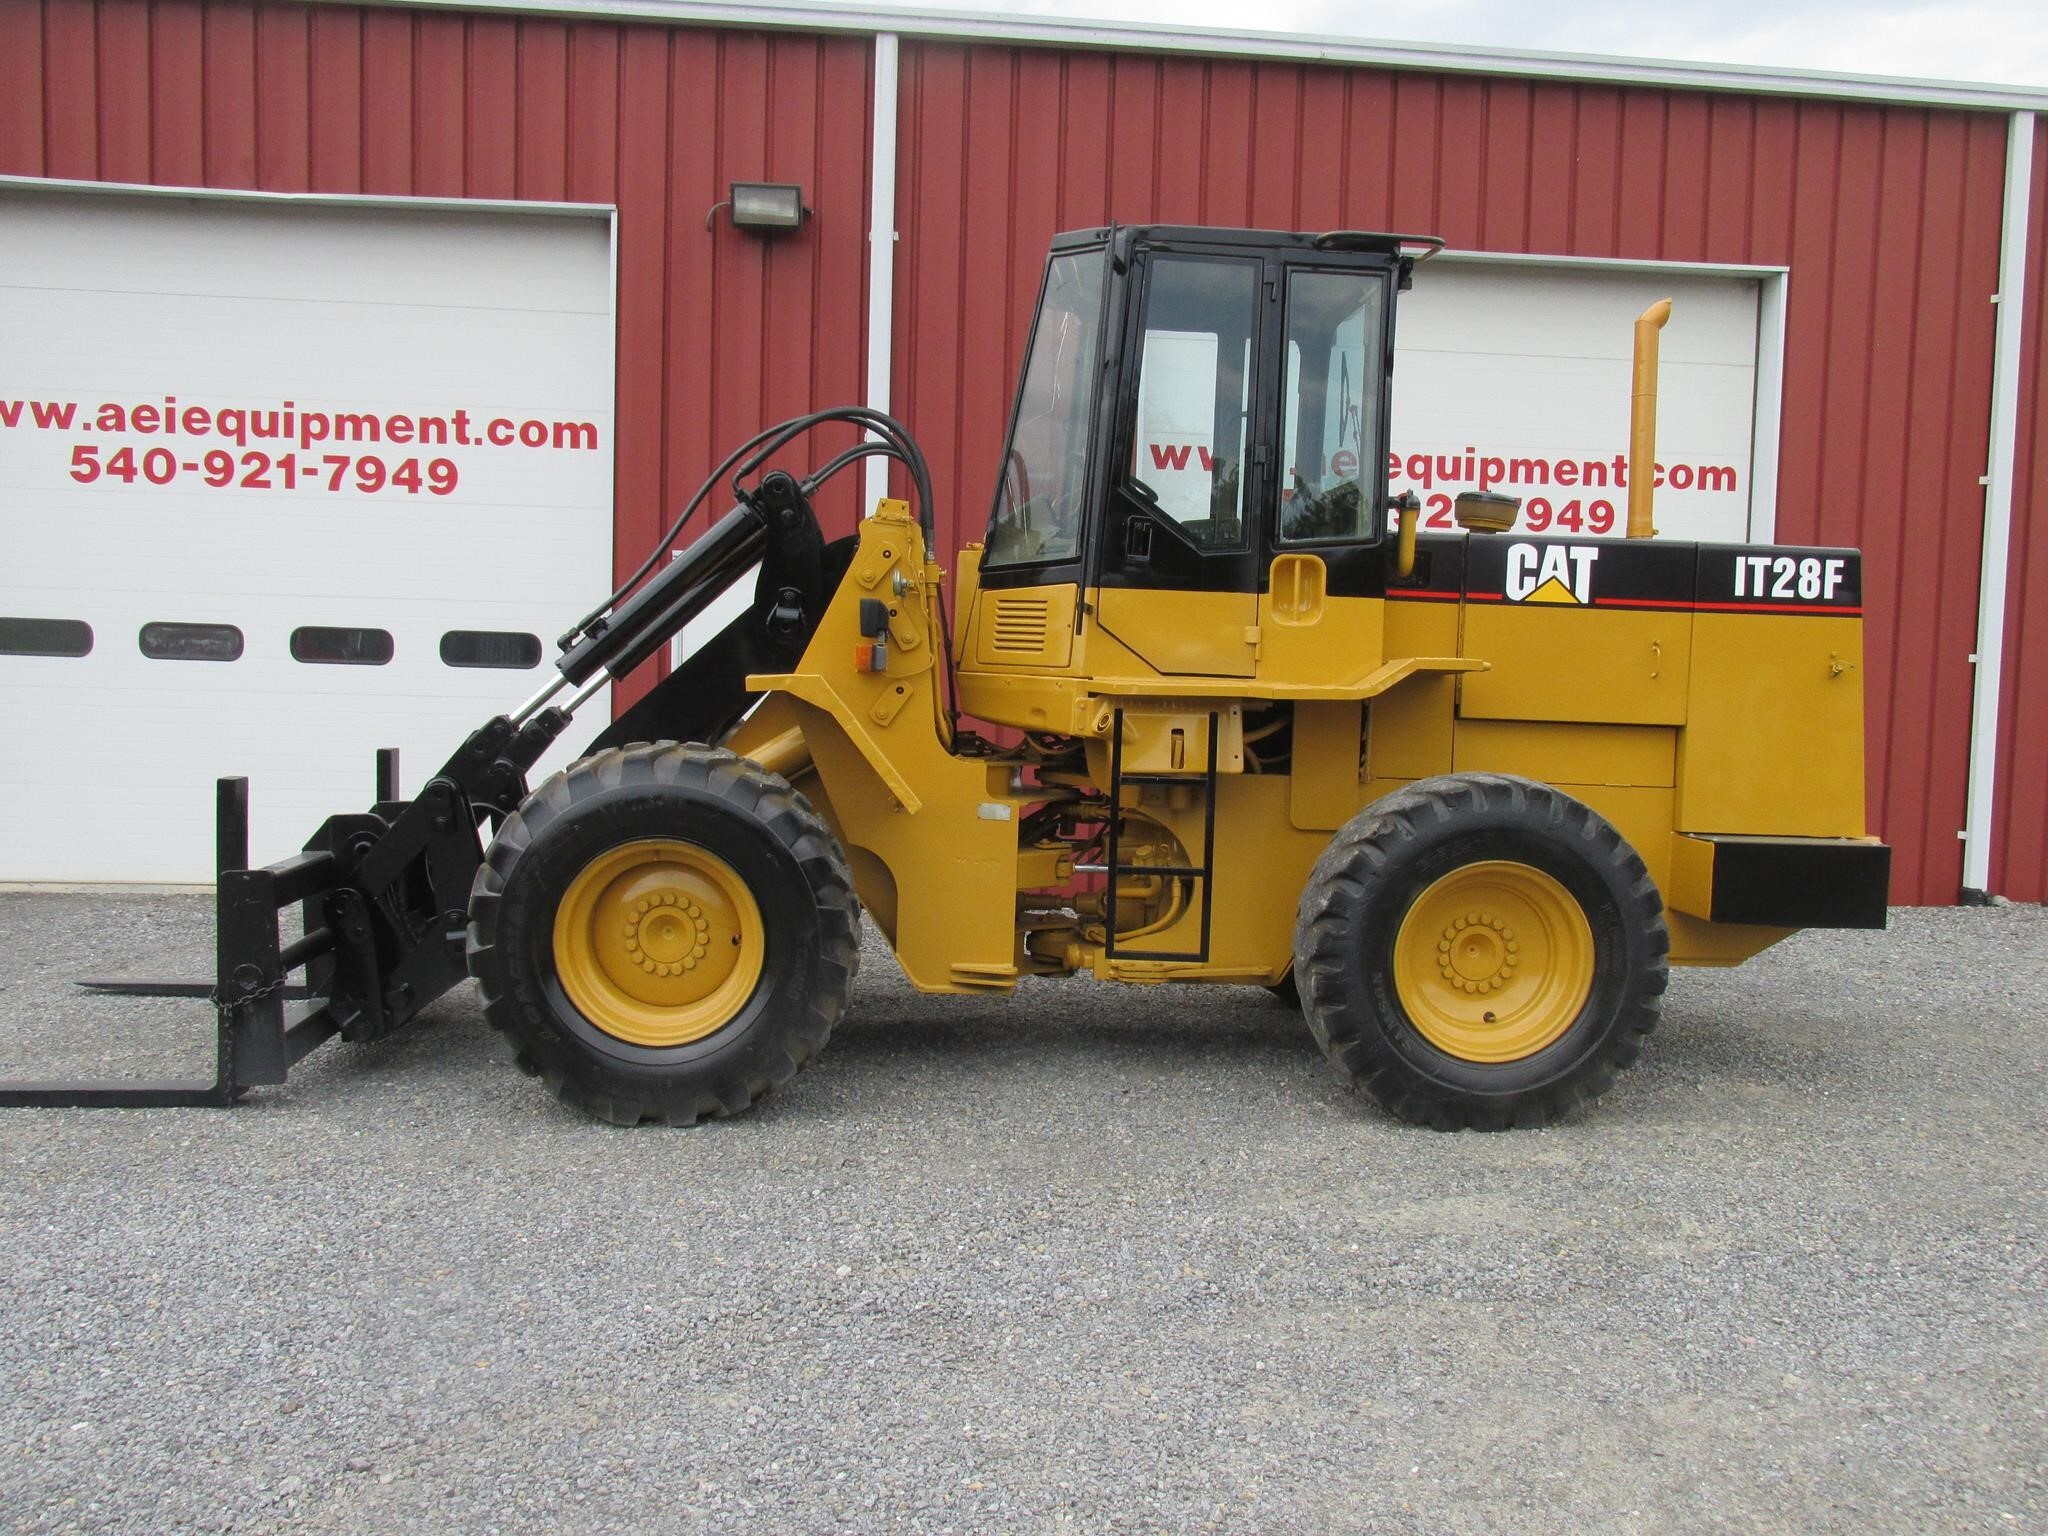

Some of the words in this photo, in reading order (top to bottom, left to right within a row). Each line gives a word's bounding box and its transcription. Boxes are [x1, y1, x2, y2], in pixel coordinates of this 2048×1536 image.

[69, 445, 459, 496] 540-921-7949
[1505, 543, 1599, 604] CAT
[1734, 556, 1845, 600] IT28F
